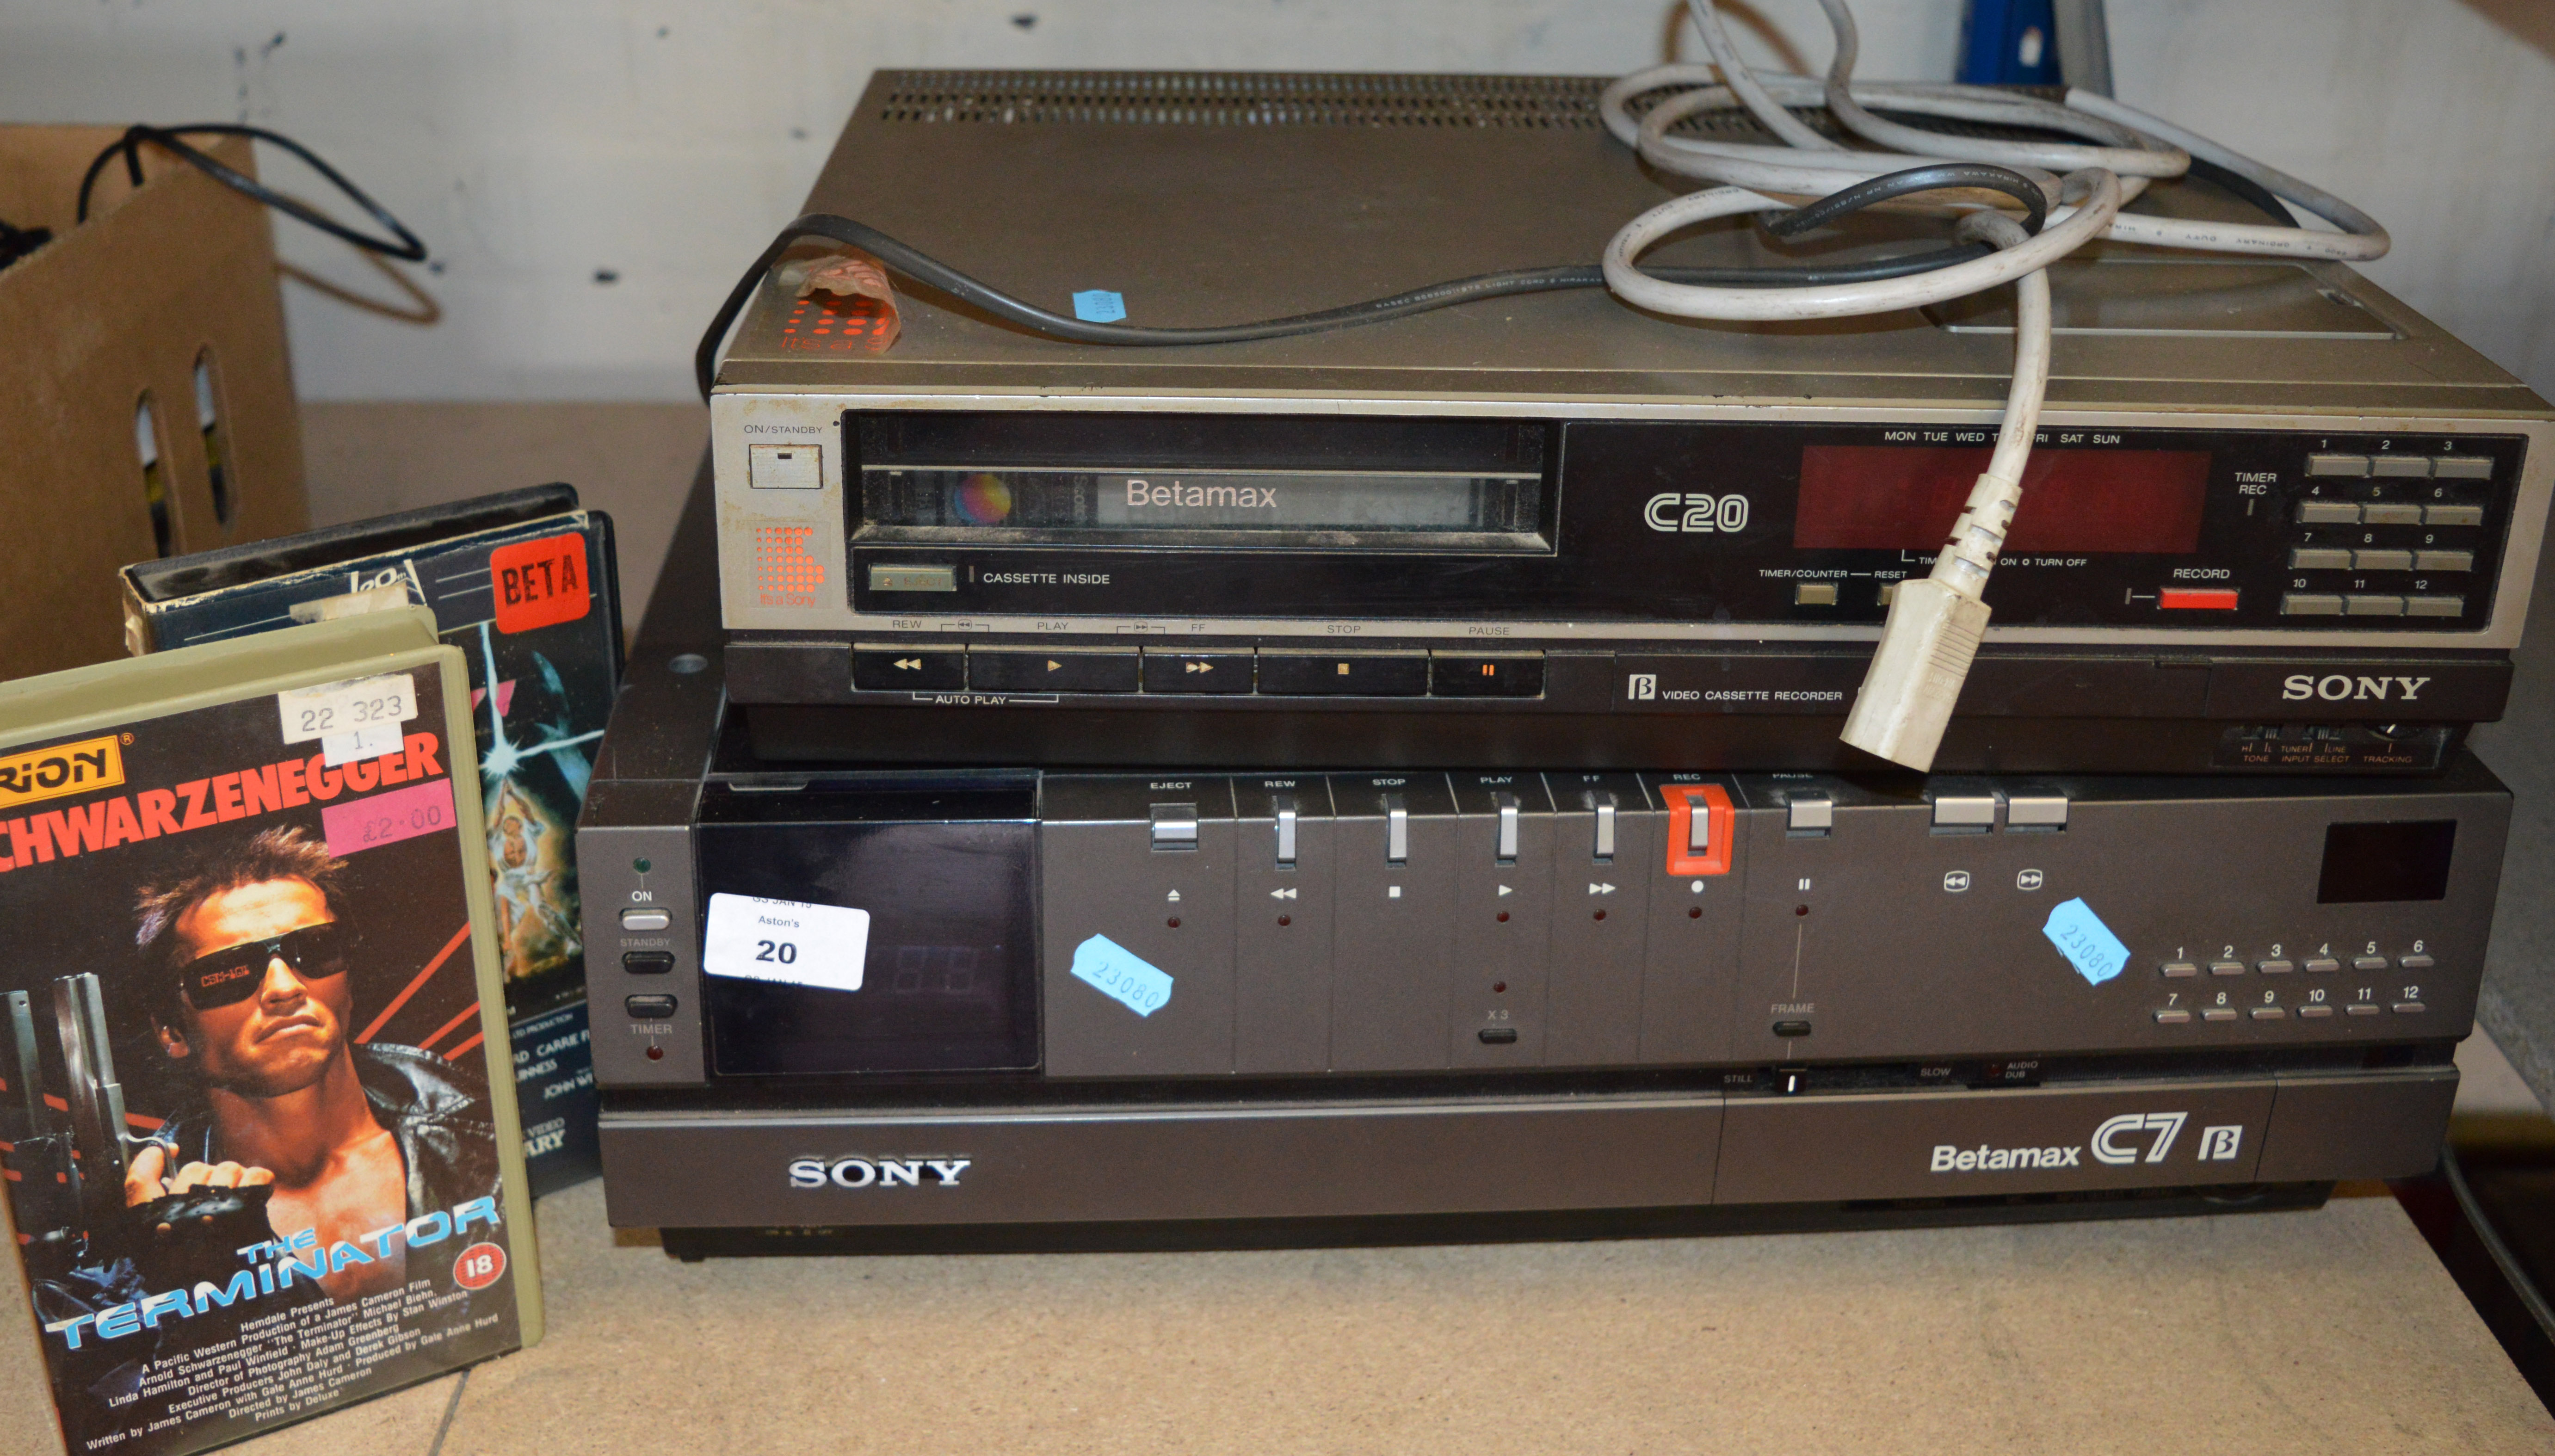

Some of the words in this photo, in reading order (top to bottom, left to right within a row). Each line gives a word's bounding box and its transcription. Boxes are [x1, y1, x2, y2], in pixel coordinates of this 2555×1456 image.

[744, 425, 823, 434] ON/STANDBY
[1884, 431, 1916, 441] MON
[1923, 432, 1949, 441] TUE
[1956, 432, 1986, 442] WED
[2060, 434, 2084, 444] SAT
[2093, 434, 2120, 444] SUN
[2321, 439, 2327, 448] 1
[2382, 440, 2390, 450] 2
[2444, 441, 2452, 450] 3
[2235, 472, 2277, 482] TIMER
[1127, 479, 1278, 508] Betamax
[2239, 485, 2267, 495] REC
[2312, 486, 2320, 495] 4
[2373, 487, 2381, 496] 5
[2434, 488, 2443, 498] 6
[1644, 493, 1748, 533] C20
[2304, 533, 2312, 542] 7
[2364, 533, 2372, 543] 8
[2425, 534, 2433, 544] 9
[2035, 558, 2062, 567] TURN
[2066, 558, 2087, 567] OFF
[983, 572, 1057, 585] CASSETTE
[1062, 573, 1111, 585] INSIDE
[1759, 569, 1848, 579] TIMER/COUNTER
[1874, 570, 1907, 579] RESET
[2173, 569, 2230, 579] RECORD
[501, 555, 580, 608] BETA
[2294, 579, 2306, 588] 10
[2354, 580, 2365, 588] 11
[2415, 580, 2427, 590] 12
[776, 596, 783, 605] a
[786, 593, 816, 608] Sony
[893, 620, 922, 629] REW
[1037, 622, 1068, 630] PLAY
[1191, 623, 1206, 632] FF
[1327, 625, 1361, 634] STOP
[1469, 627, 1510, 636] PAUSE
[2283, 675, 2430, 701] SONY
[936, 695, 971, 704] AUTO
[975, 696, 1006, 705] PLAY
[1662, 691, 1699, 700] VIDEO
[1705, 691, 1769, 701] CASSETTE
[1774, 691, 1842, 701] RECORDER
[301, 708, 334, 732] 22
[353, 695, 402, 722] 323
[1150, 782, 1192, 790] EJECT
[632, 891, 652, 901] ON
[758, 915, 800, 928] Aston's
[620, 938, 670, 947] STANDBY
[755, 940, 797, 964] 20
[2060, 925, 2112, 977] 23080
[2177, 947, 2184, 959] 1
[2223, 945, 2234, 958] 2
[2271, 944, 2281, 957] 3
[2319, 943, 2328, 955] 4
[2366, 941, 2376, 954] 5
[2413, 940, 2423, 953] 6
[1092, 962, 1159, 1008] 23080
[2168, 993, 2178, 1006] 7
[2216, 992, 2227, 1005] 8
[2264, 991, 2274, 1003] 9
[2309, 989, 2325, 1002] 10
[2358, 988, 2371, 1000] 11
[2404, 986, 2419, 999] 12
[1771, 1003, 1814, 1014] FRAME
[630, 1024, 672, 1034] TIMER
[537, 1033, 579, 1057] CARRIE
[1921, 1067, 1951, 1077] SLOW
[2007, 1061, 2038, 1070] AUDIO
[1724, 1074, 1753, 1083] STILL
[2005, 1071, 2025, 1079] DUB
[543, 1078, 576, 1099] JOHN
[527, 1117, 565, 1138] VIDEO
[1930, 1145, 2081, 1172] Betamax
[2091, 1111, 2188, 1164] C7
[789, 1159, 971, 1188] SONY
[237, 1227, 317, 1265] THE
[467, 1254, 494, 1278] 18
[45, 1196, 501, 1350] TERMINATOR
[240, 1312, 286, 1333] Hemdale
[290, 1297, 334, 1316] Presents
[154, 1353, 189, 1370] Pacific
[194, 1341, 236, 1358] Western
[241, 1322, 296, 1345] Production
[325, 1302, 358, 1319] James
[361, 1288, 405, 1308] Cameron
[409, 1279, 431, 1292] Film
[139, 1370, 173, 1388] Arnold
[179, 1344, 262, 1376] Schwarzenegger
[364, 1301, 402, 1319] Michael
[406, 1290, 437, 1305] Biehn,
[109, 1392, 139, 1407] Linda
[143, 1376, 190, 1397] Hamilton
[195, 1369, 213, 1382] and
[219, 1362, 241, 1375] Paul
[246, 1346, 288, 1365] Winfield
[301, 1330, 345, 1350] Make-Up
[349, 1318, 383, 1334] Effects
[386, 1311, 399, 1323] By
[403, 1304, 424, 1317] Stan
[428, 1290, 468, 1309] Winston
[188, 1376, 229, 1396] Director
[249, 1352, 311, 1377] Photography
[316, 1342, 344, 1357] Adam
[349, 1324, 399, 1347] Greenberg
[168, 1393, 218, 1414] Executive
[222, 1374, 274, 1395] Producers
[278, 1366, 302, 1381] John
[307, 1357, 329, 1372] Daly
[333, 1350, 351, 1363] and
[356, 1341, 384, 1356] Derek
[388, 1327, 421, 1345] Gibson
[87, 1431, 126, 1450] Written
[131, 1425, 143, 1437] by
[148, 1416, 181, 1432] James
[185, 1400, 231, 1420] Cameron
[236, 1389, 257, 1405] with
[262, 1382, 284, 1396] Gale
[289, 1374, 314, 1388] Anne
[319, 1364, 343, 1380] Hurd
[356, 1346, 401, 1367] Produced
[421, 1332, 442, 1345] Gale
[447, 1323, 471, 1338] Anne
[475, 1313, 499, 1328] Hurd
[229, 1398, 271, 1419] Directed
[292, 1382, 324, 1399] James
[328, 1367, 372, 1388] Cameron
[255, 1404, 284, 1421] Prints
[306, 1389, 339, 1407] Deluxe
